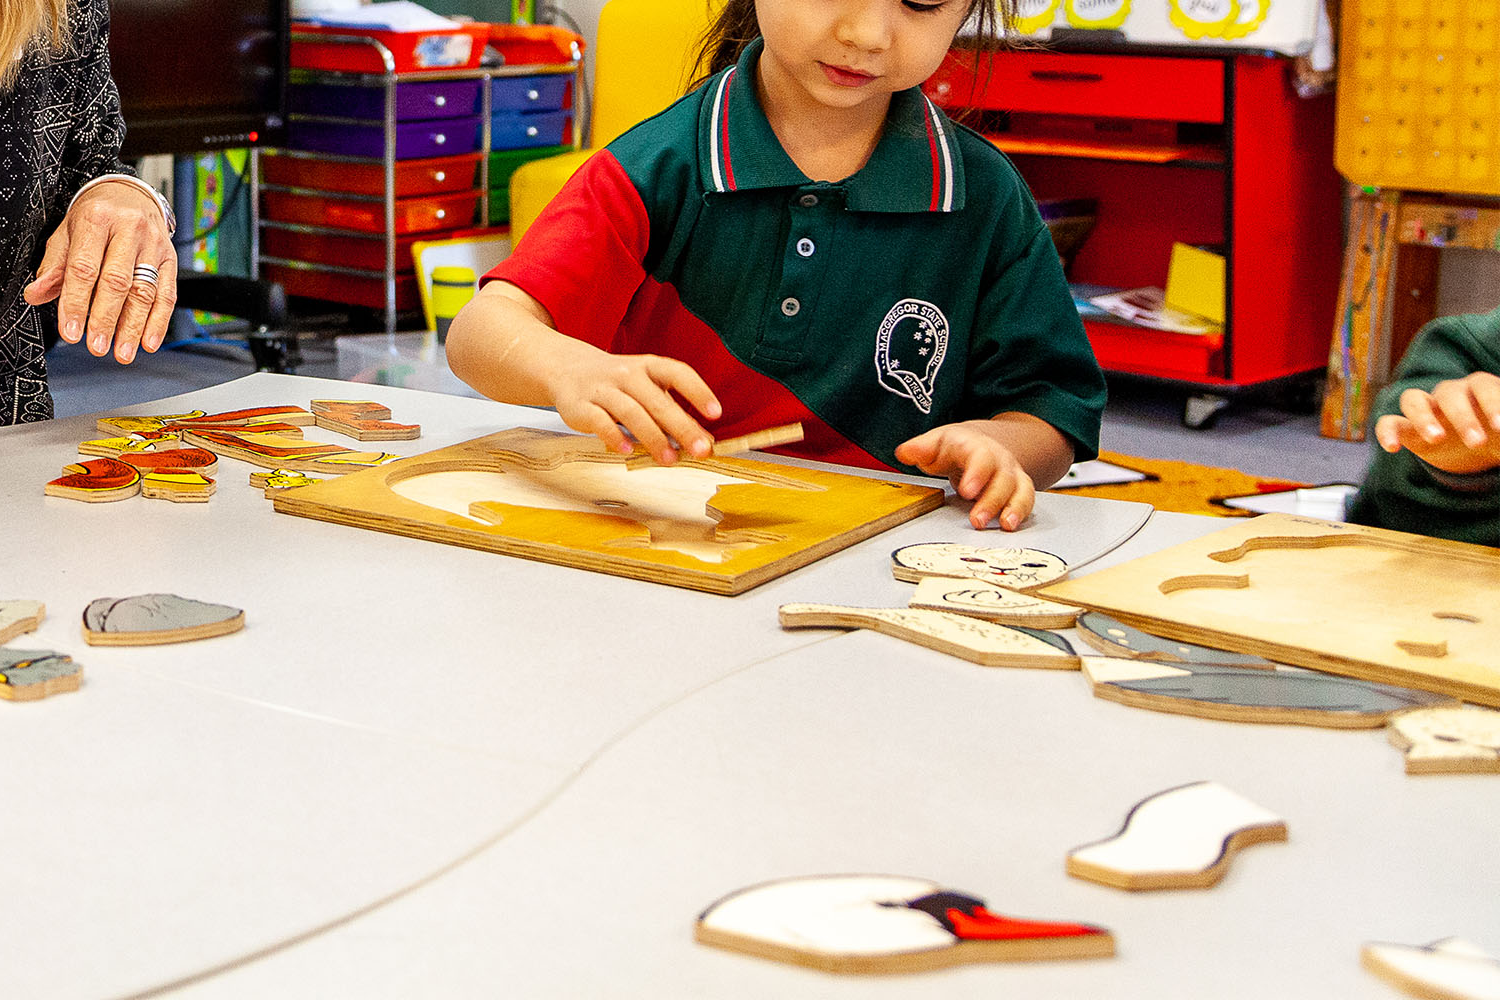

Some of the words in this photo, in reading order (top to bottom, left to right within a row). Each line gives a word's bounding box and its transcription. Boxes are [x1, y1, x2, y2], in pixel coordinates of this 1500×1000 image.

[879, 303, 920, 352] MACGREGOR
[920, 305, 944, 330] STATE
[930, 328, 948, 368] SCHOOL
